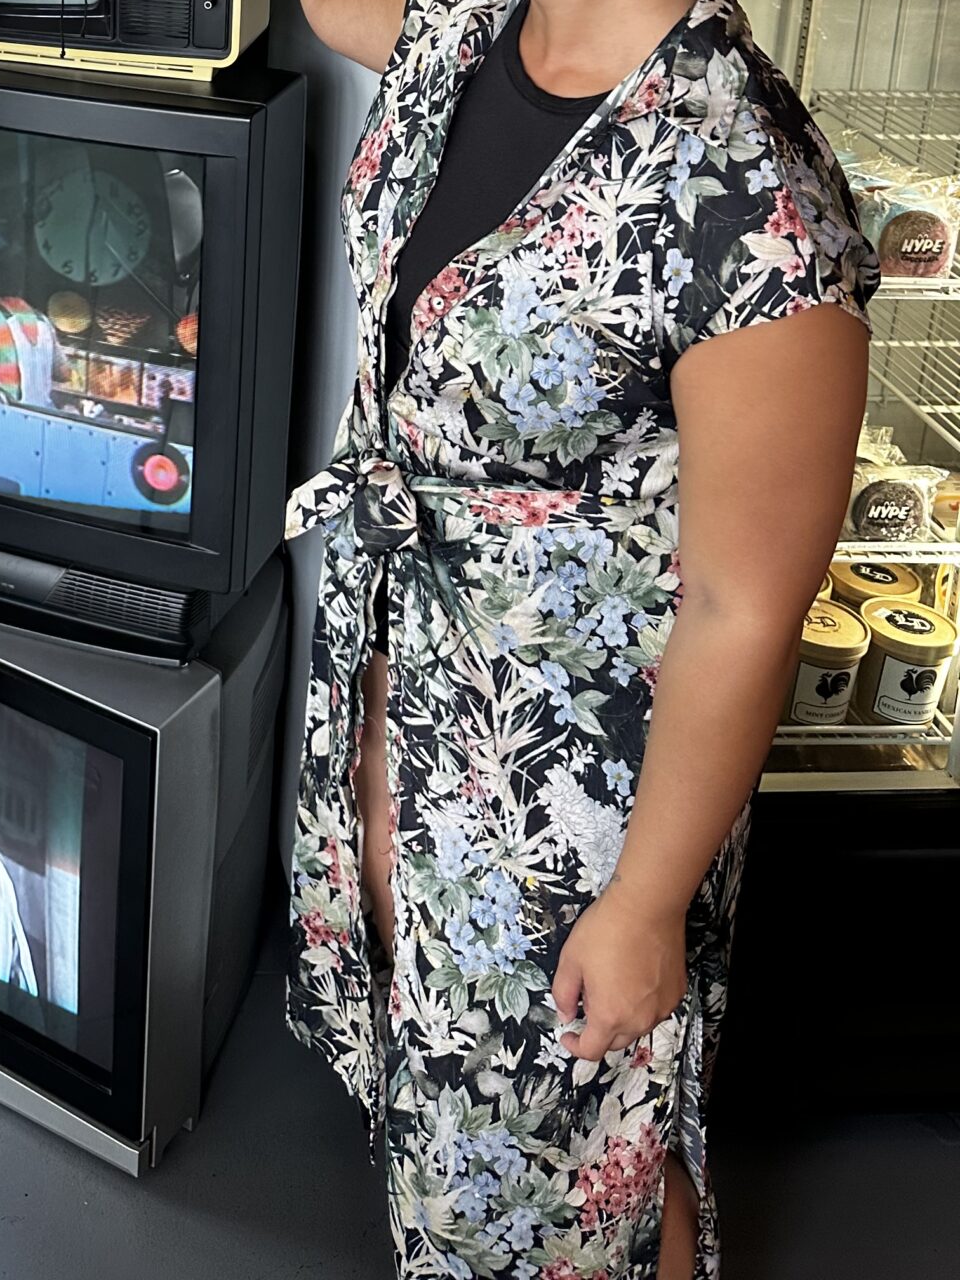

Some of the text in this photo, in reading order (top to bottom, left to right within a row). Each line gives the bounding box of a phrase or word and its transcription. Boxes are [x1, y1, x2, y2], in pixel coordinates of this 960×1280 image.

[901, 238, 945, 254] HYPE
[868, 505, 910, 520] HYPE
[881, 701, 912, 715] MEXICAN
